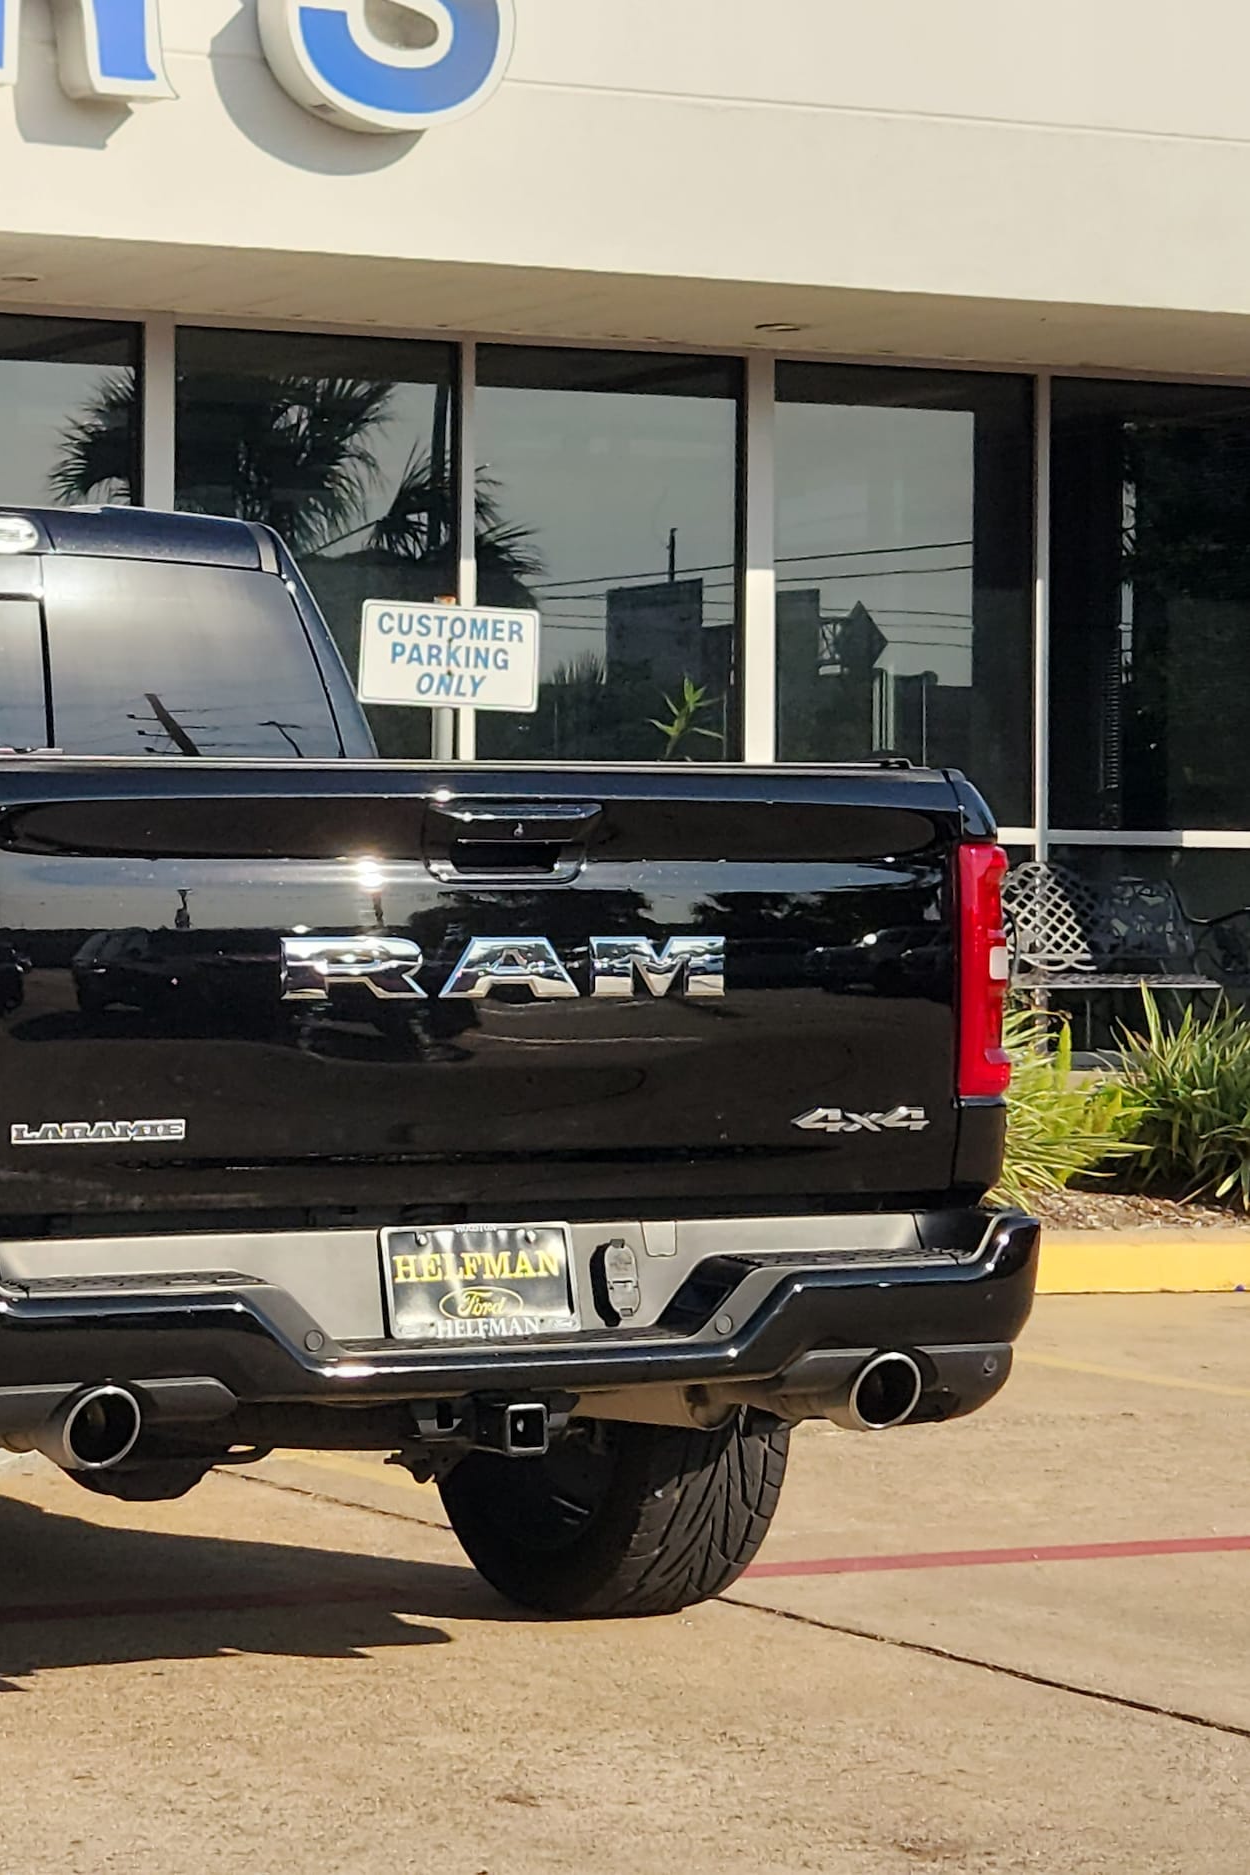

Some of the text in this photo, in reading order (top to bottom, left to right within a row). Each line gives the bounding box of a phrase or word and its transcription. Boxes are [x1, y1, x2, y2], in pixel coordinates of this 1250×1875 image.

[377, 611, 524, 643] CUSTOMER
[390, 642, 509, 670] PARKING
[416, 672, 487, 698] ONLY
[280, 935, 726, 1001] RAM
[11, 1119, 186, 1145] LARAMIE
[790, 1106, 931, 1132] 4x4
[393, 1250, 560, 1284] HELFMAN
[457, 1291, 505, 1316] Ford
[436, 1317, 541, 1338] HELFMAN
